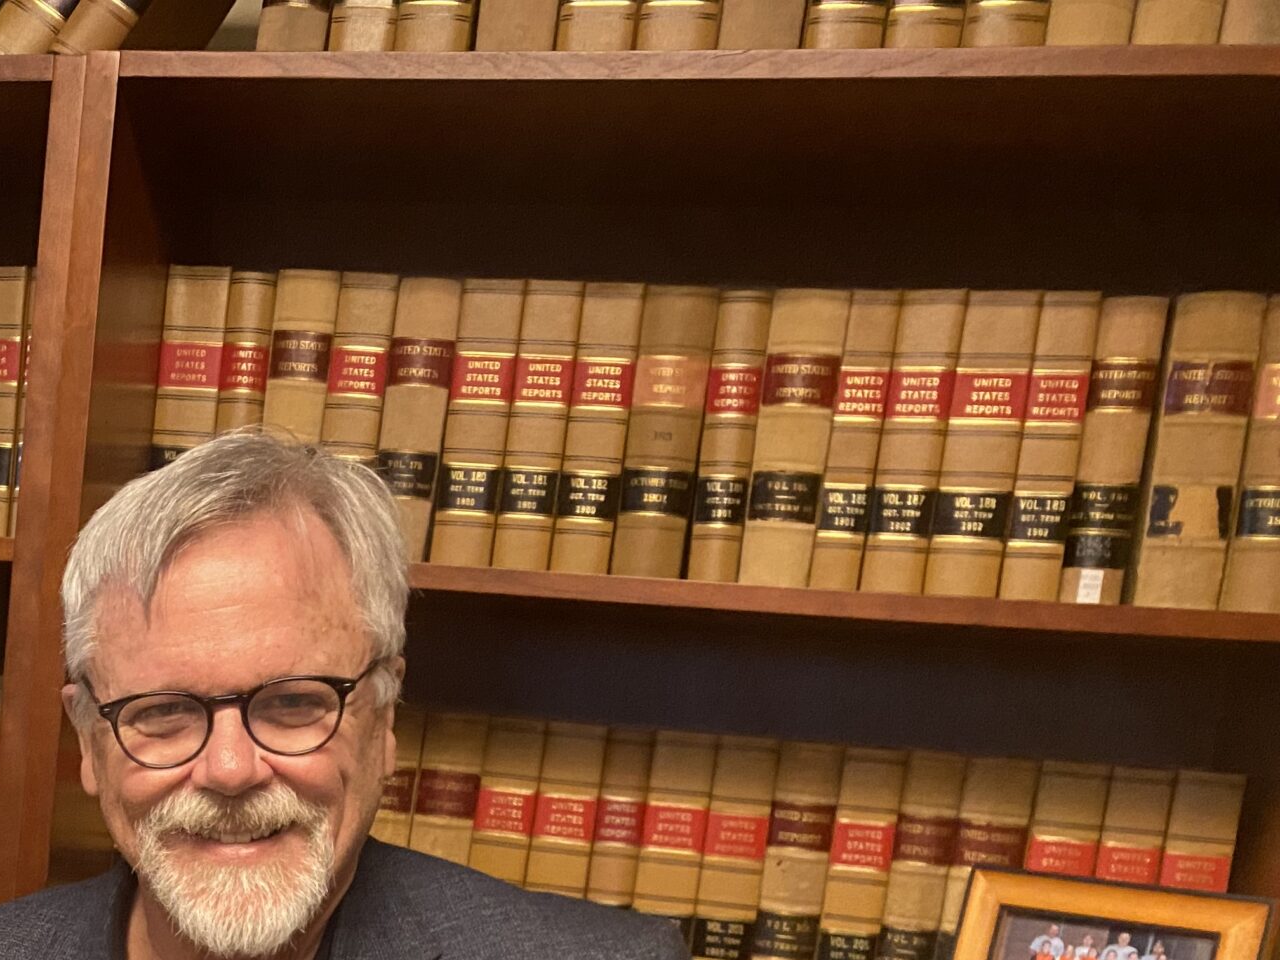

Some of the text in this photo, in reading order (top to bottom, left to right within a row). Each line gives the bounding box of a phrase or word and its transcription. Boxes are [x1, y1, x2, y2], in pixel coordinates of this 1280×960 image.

[176, 348, 206, 358] UNITED
[175, 360, 206, 370] STATES
[345, 355, 376, 365] UNITED
[468, 360, 501, 370] UNITED
[342, 367, 375, 377] STATES
[529, 362, 562, 373] UNITED
[588, 365, 622, 376] UNITED
[170, 372, 207, 383] REPORTS
[466, 373, 500, 383] STATES
[527, 376, 560, 386] STATES
[846, 376, 883, 385] UNITED
[902, 376, 940, 386] UNITED
[338, 380, 376, 391] REPORTS
[586, 378, 621, 389] STATES
[973, 378, 1012, 388] UNITED
[1040, 379, 1079, 388] UNITED
[461, 385, 501, 396] REPORTS
[522, 388, 563, 399] REPORTS
[844, 390, 881, 398] STATES
[900, 390, 938, 400] STATES
[971, 390, 1010, 401] STATES
[581, 392, 622, 402] REPORTS
[1038, 393, 1077, 402] STATES
[839, 402, 882, 412] REPORTS
[896, 403, 940, 413] REPORTS
[965, 404, 1012, 415] REPORTS
[1032, 406, 1079, 417] REPORTS
[592, 479, 608, 490] 182
[1020, 500, 1042, 510] VOL.
[491, 796, 523, 805] UNITED
[551, 802, 584, 812] UNITED
[489, 808, 522, 818] STATES
[658, 811, 692, 822] UNITED
[550, 814, 583, 824] STATES
[485, 819, 523, 830] REPORTS
[656, 823, 691, 833] STATES
[721, 820, 755, 830] UNITED
[545, 825, 583, 836] REPORTS
[847, 829, 882, 840] UNITED
[652, 835, 693, 846] REPORTS
[719, 832, 754, 842] STATES
[846, 842, 881, 853] STATES
[841, 853, 883, 865] REPORTS
